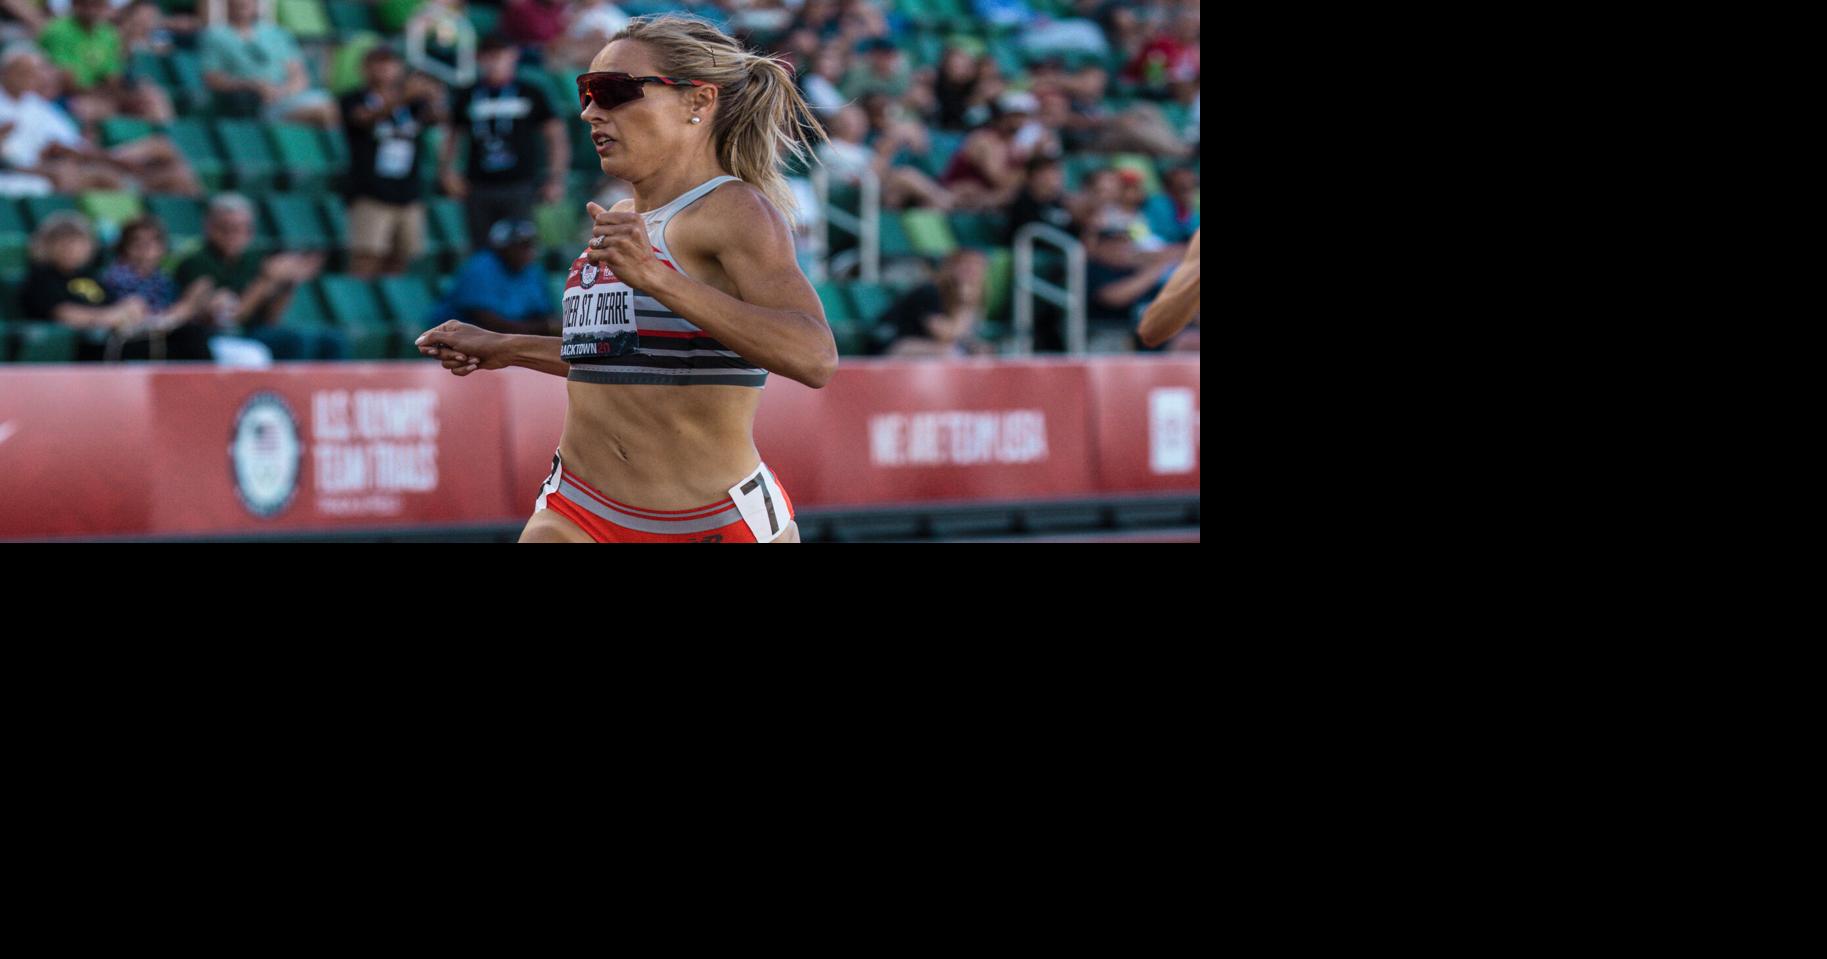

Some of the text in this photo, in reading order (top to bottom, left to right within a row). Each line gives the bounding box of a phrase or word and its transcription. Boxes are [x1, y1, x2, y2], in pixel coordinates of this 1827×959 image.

[580, 293, 594, 326] ST.
[594, 291, 630, 325] PIERRE
[740, 471, 780, 536] 7
